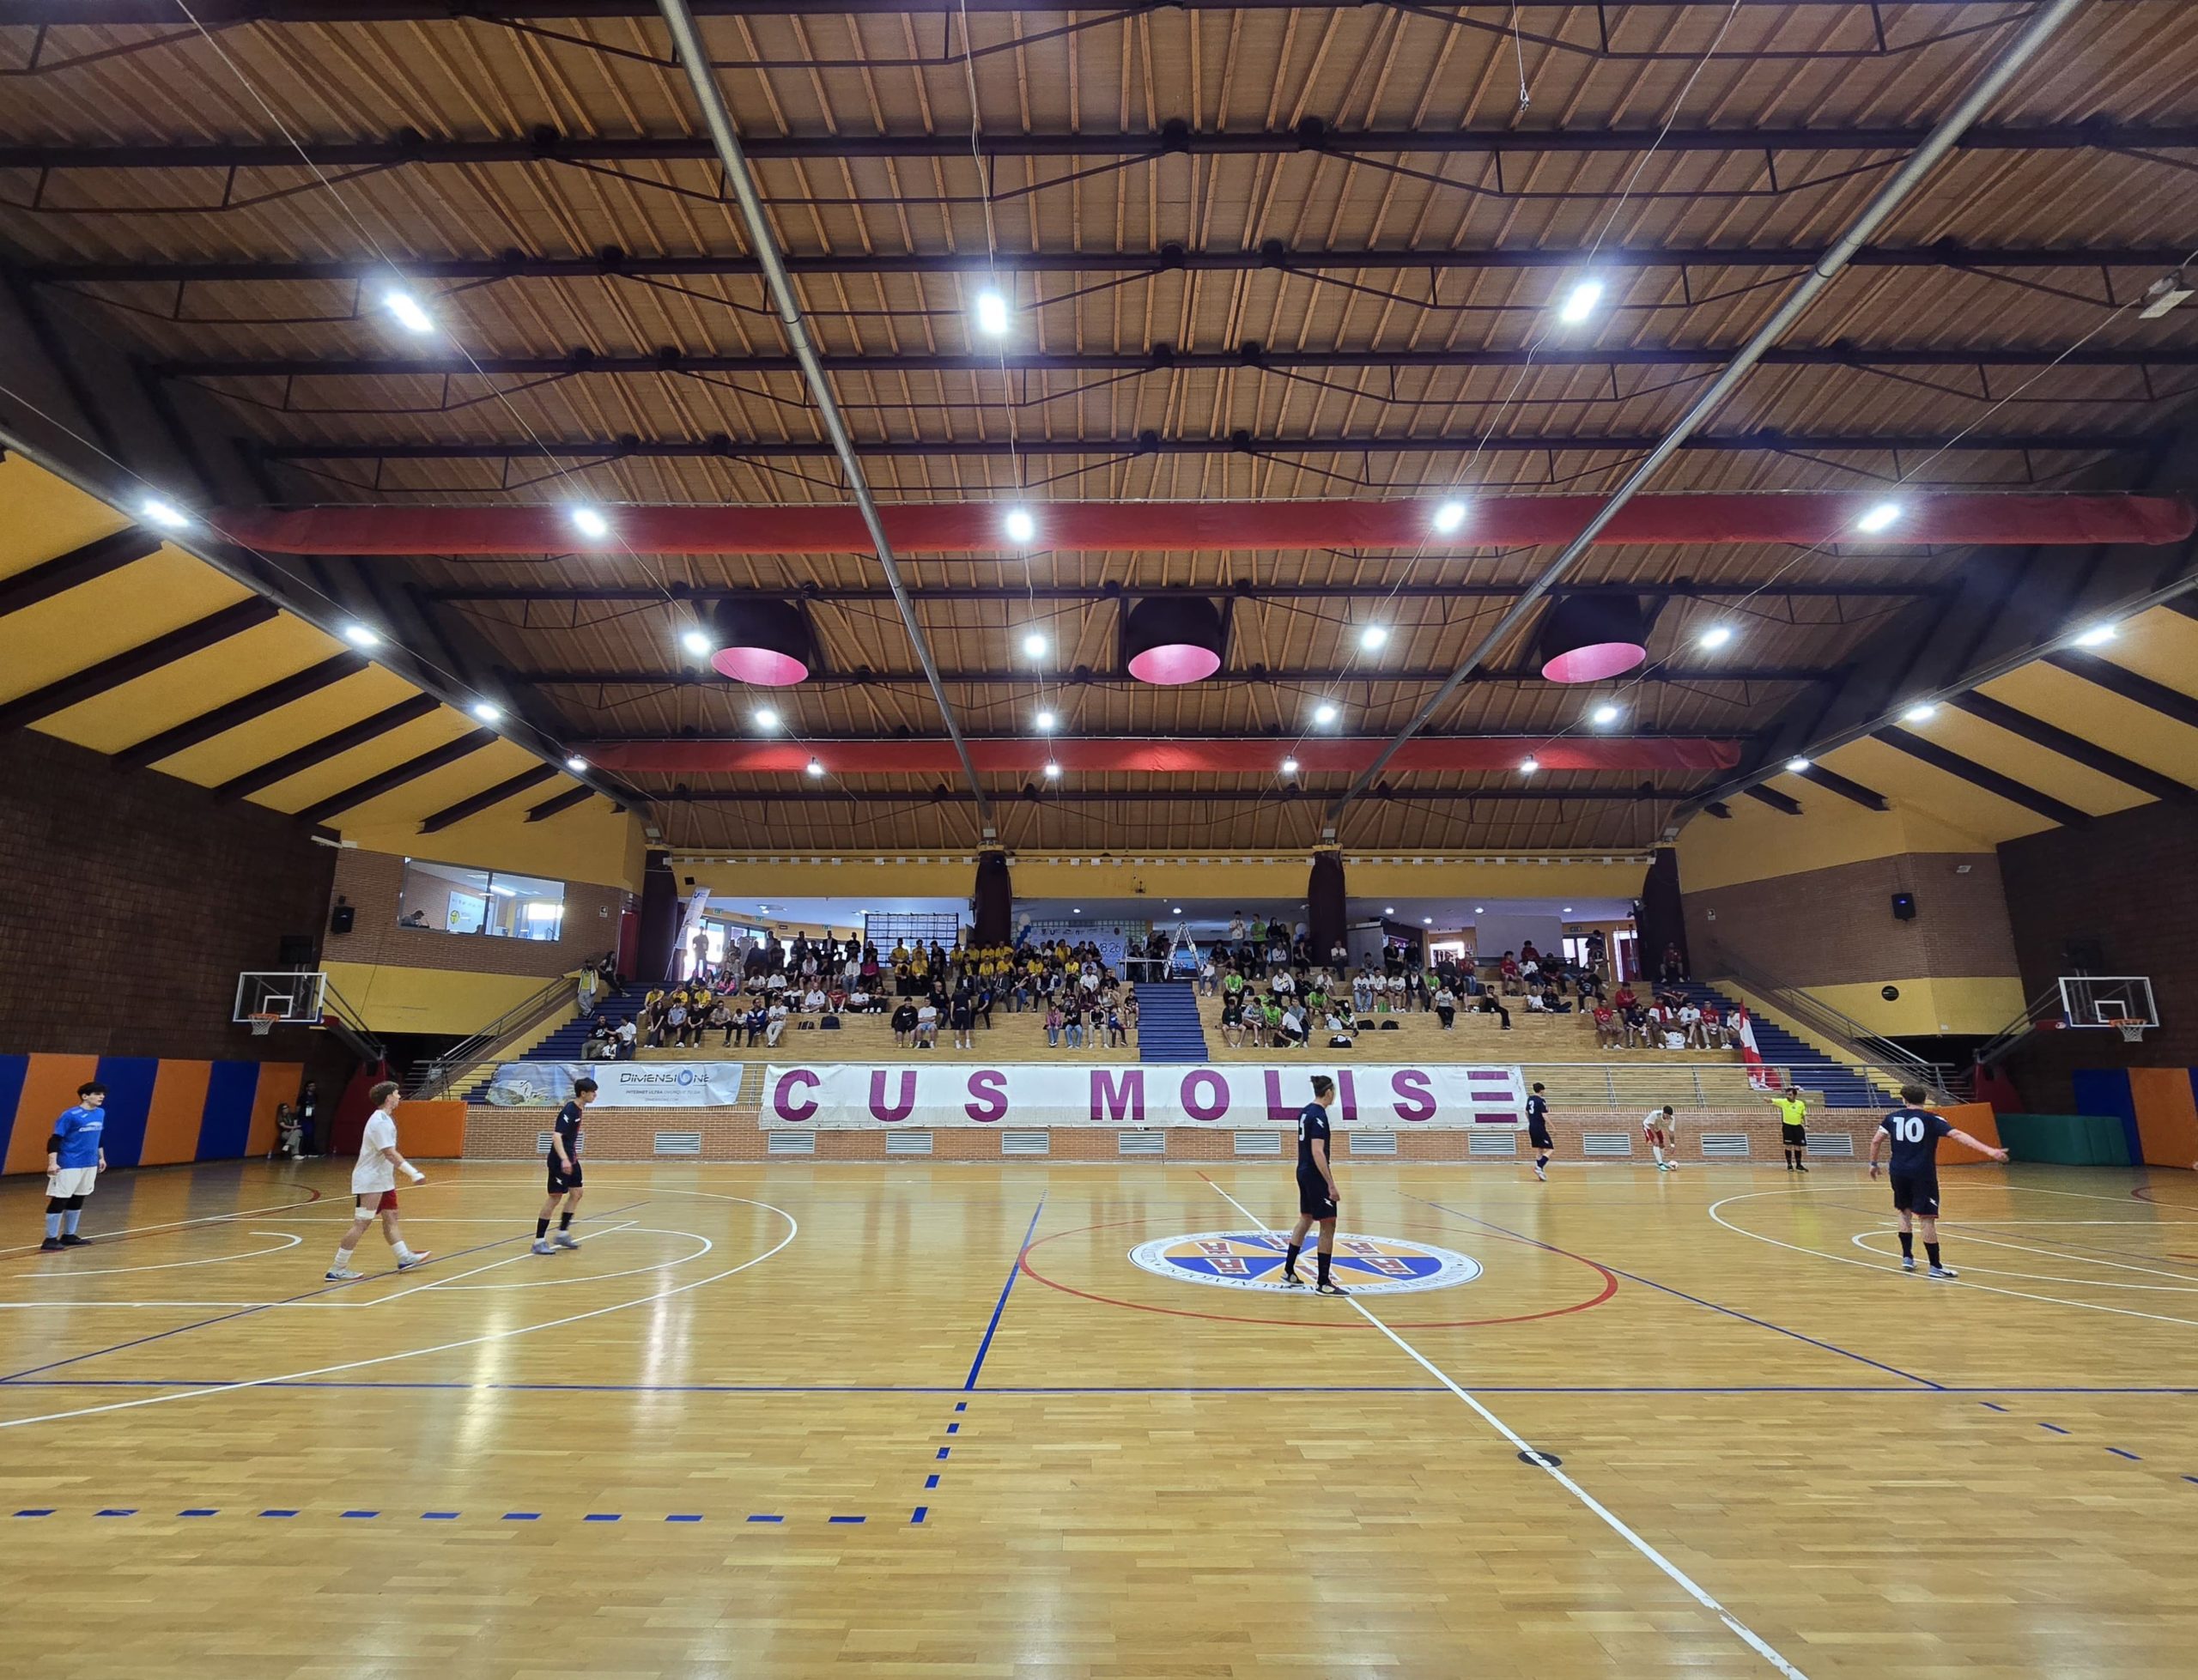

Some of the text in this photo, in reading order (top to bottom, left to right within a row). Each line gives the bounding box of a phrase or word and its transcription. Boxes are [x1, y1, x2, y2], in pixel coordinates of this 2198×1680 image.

[773, 1069, 1518, 1124] CUS MOLISE
[1528, 1100, 1535, 1115] 3
[1893, 1116, 1925, 1143] 10
